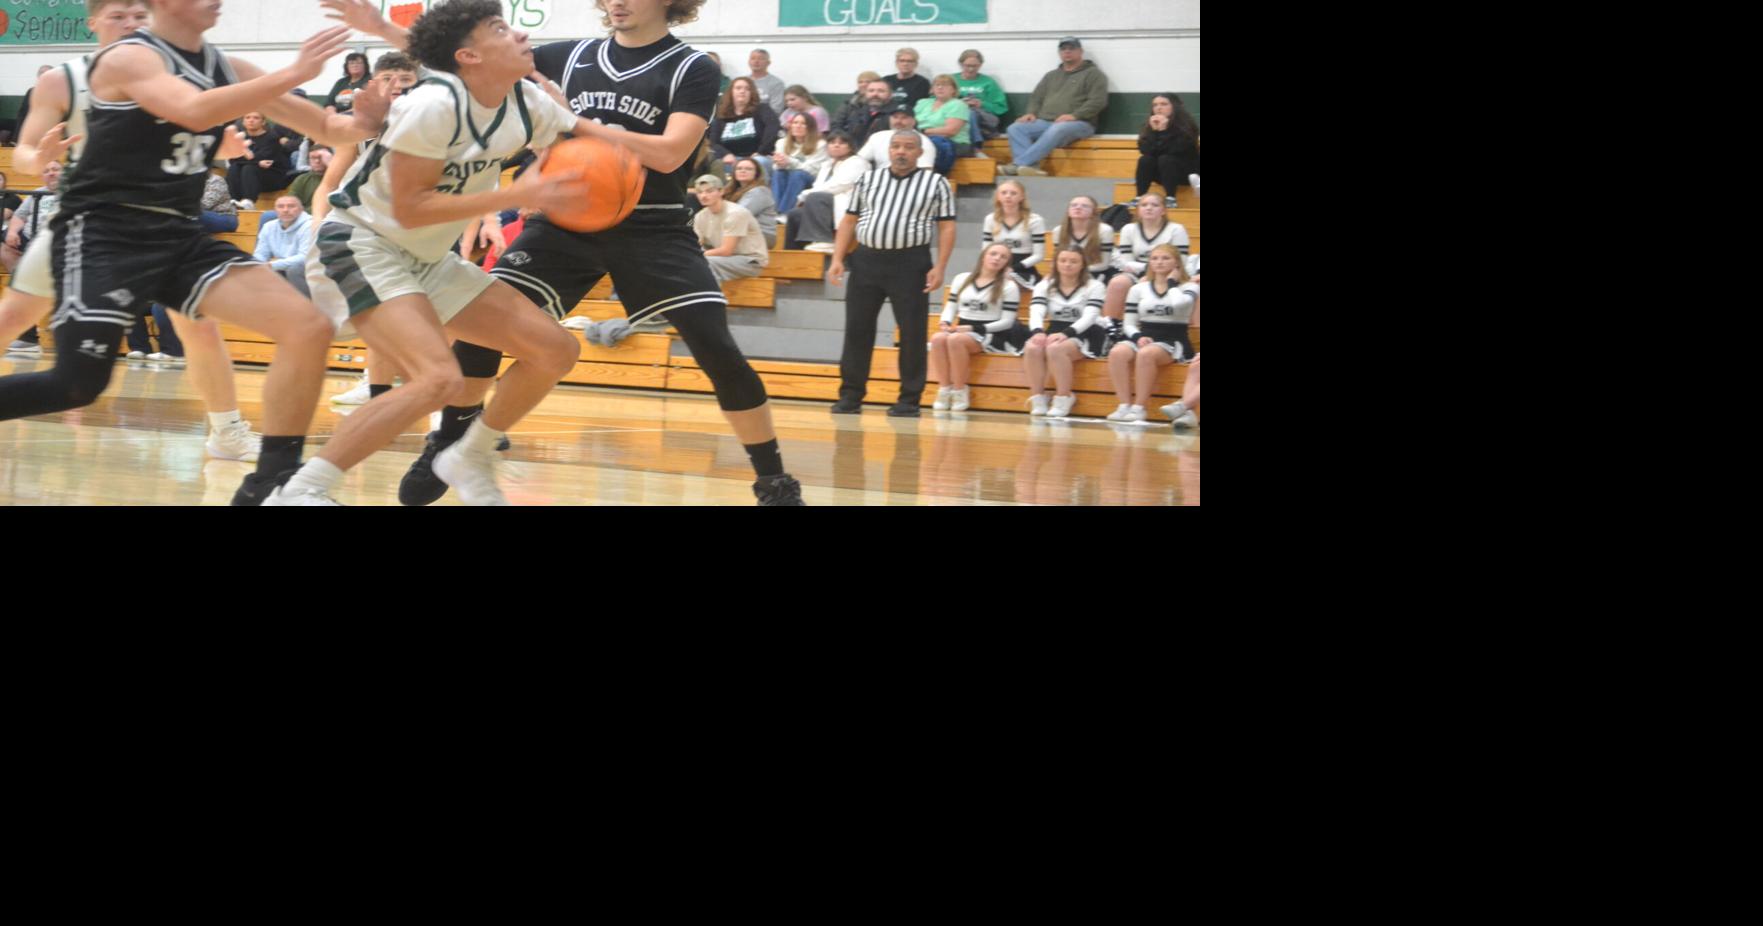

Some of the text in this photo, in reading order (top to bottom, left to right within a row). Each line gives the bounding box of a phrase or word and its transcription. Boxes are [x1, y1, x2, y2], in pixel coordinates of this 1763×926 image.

[823, 0, 939, 24] GOALS
[570, 91, 616, 114] SOUTH
[618, 95, 662, 125] SIDE
